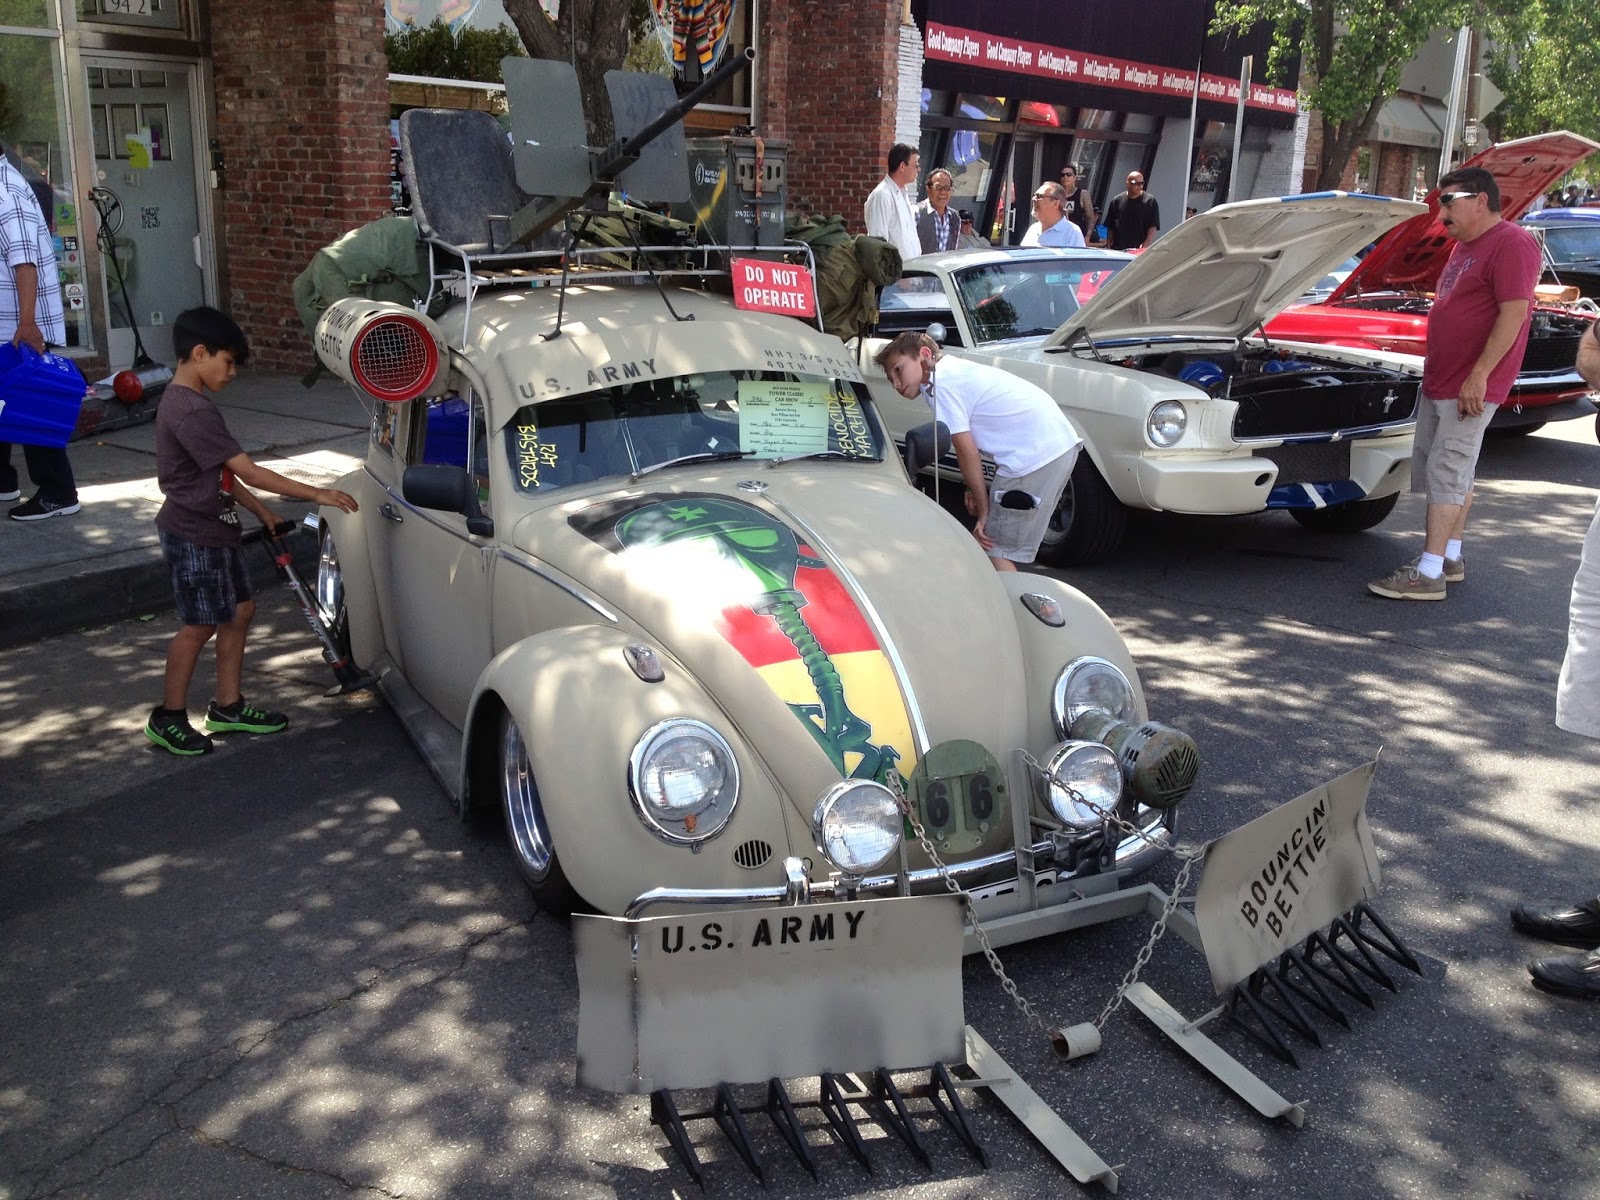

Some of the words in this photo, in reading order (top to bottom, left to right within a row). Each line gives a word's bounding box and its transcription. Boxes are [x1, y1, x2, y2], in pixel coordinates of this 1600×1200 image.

[928, 28, 942, 50] Good
[942, 31, 964, 58] Company
[963, 35, 980, 60] Players
[987, 40, 999, 60] Good
[999, 42, 1018, 67] Company
[1017, 45, 1032, 68] Players
[1038, 50, 1049, 68] Good
[1048, 52, 1066, 75] Company
[1065, 55, 1078, 76] Players
[744, 265, 765, 283] DO
[771, 268, 798, 287] NOT
[743, 287, 806, 310] OPERATE
[323, 306, 360, 333] BOUNCIN
[321, 331, 343, 360] BETTIE
[827, 357, 853, 369] PLT
[519, 377, 571, 399] U.S.
[586, 358, 657, 386] ARMY
[838, 391, 873, 457] MACHINE
[517, 424, 540, 488] BASTARDS
[540, 443, 558, 468] RAT
[925, 774, 993, 828] 66
[1240, 799, 1326, 928] BOUNCIN
[1265, 826, 1326, 938] BETTIE
[662, 923, 735, 953] U.S.
[752, 910, 866, 947] ARMY
